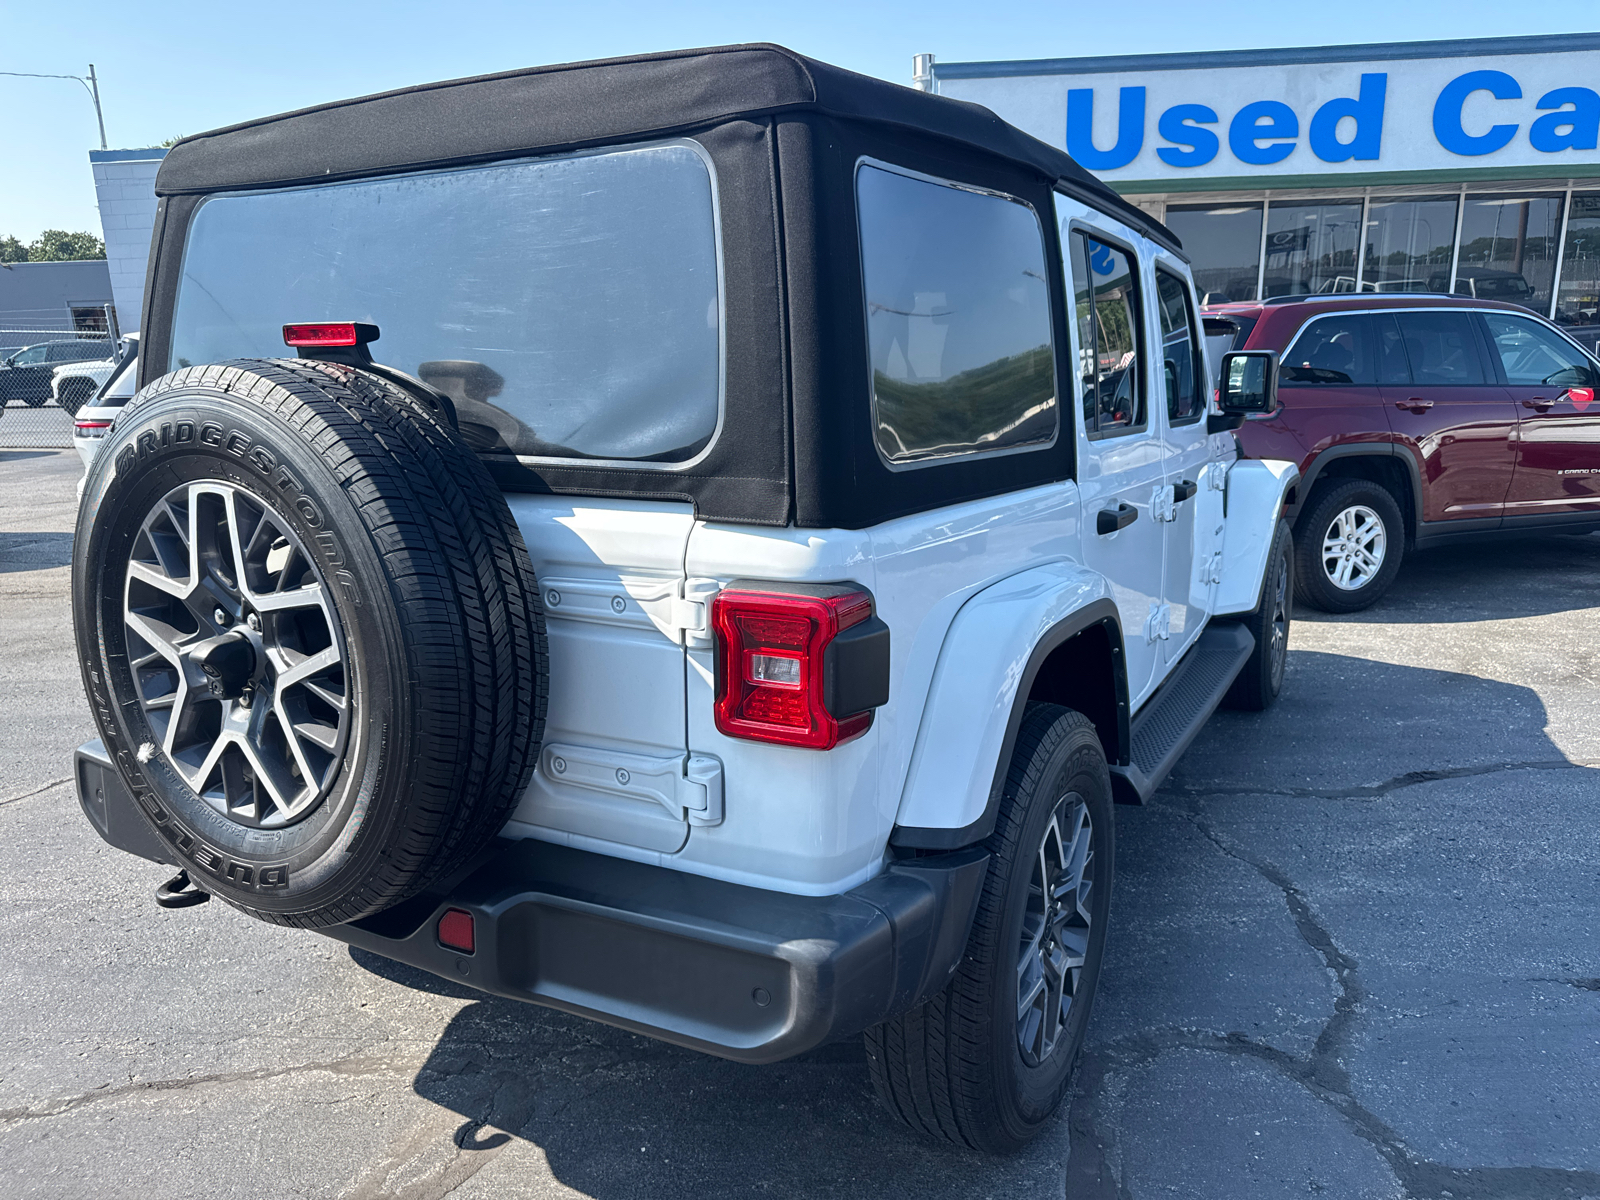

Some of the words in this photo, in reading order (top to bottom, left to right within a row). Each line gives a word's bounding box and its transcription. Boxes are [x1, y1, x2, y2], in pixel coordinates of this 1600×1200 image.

[1065, 72, 1388, 170] Used
[1432, 69, 1600, 157] Ca
[114, 418, 363, 608] BRIDGESTONE
[115, 747, 291, 891] DUELER
